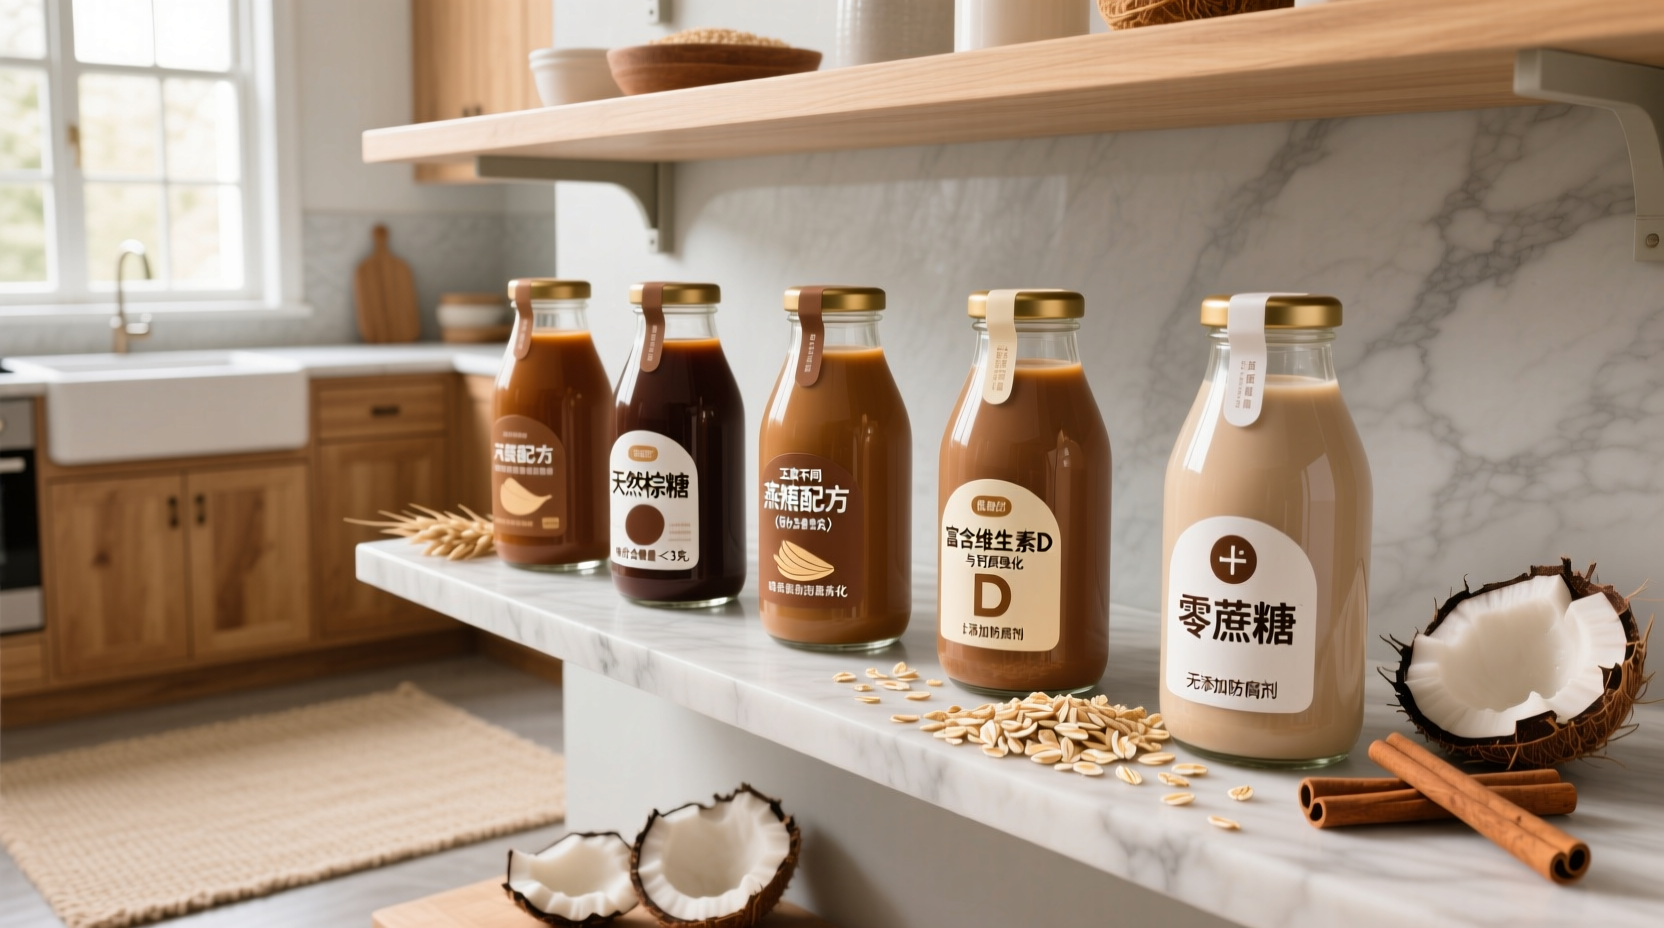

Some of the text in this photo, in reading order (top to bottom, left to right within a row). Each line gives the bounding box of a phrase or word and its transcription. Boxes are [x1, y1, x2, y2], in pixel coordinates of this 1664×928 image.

[612, 471, 690, 499] 天然棕糖
[946, 525, 1053, 553] 富含维生素D
[974, 573, 1012, 617] D
[1179, 593, 1296, 645] 零蔗糖
